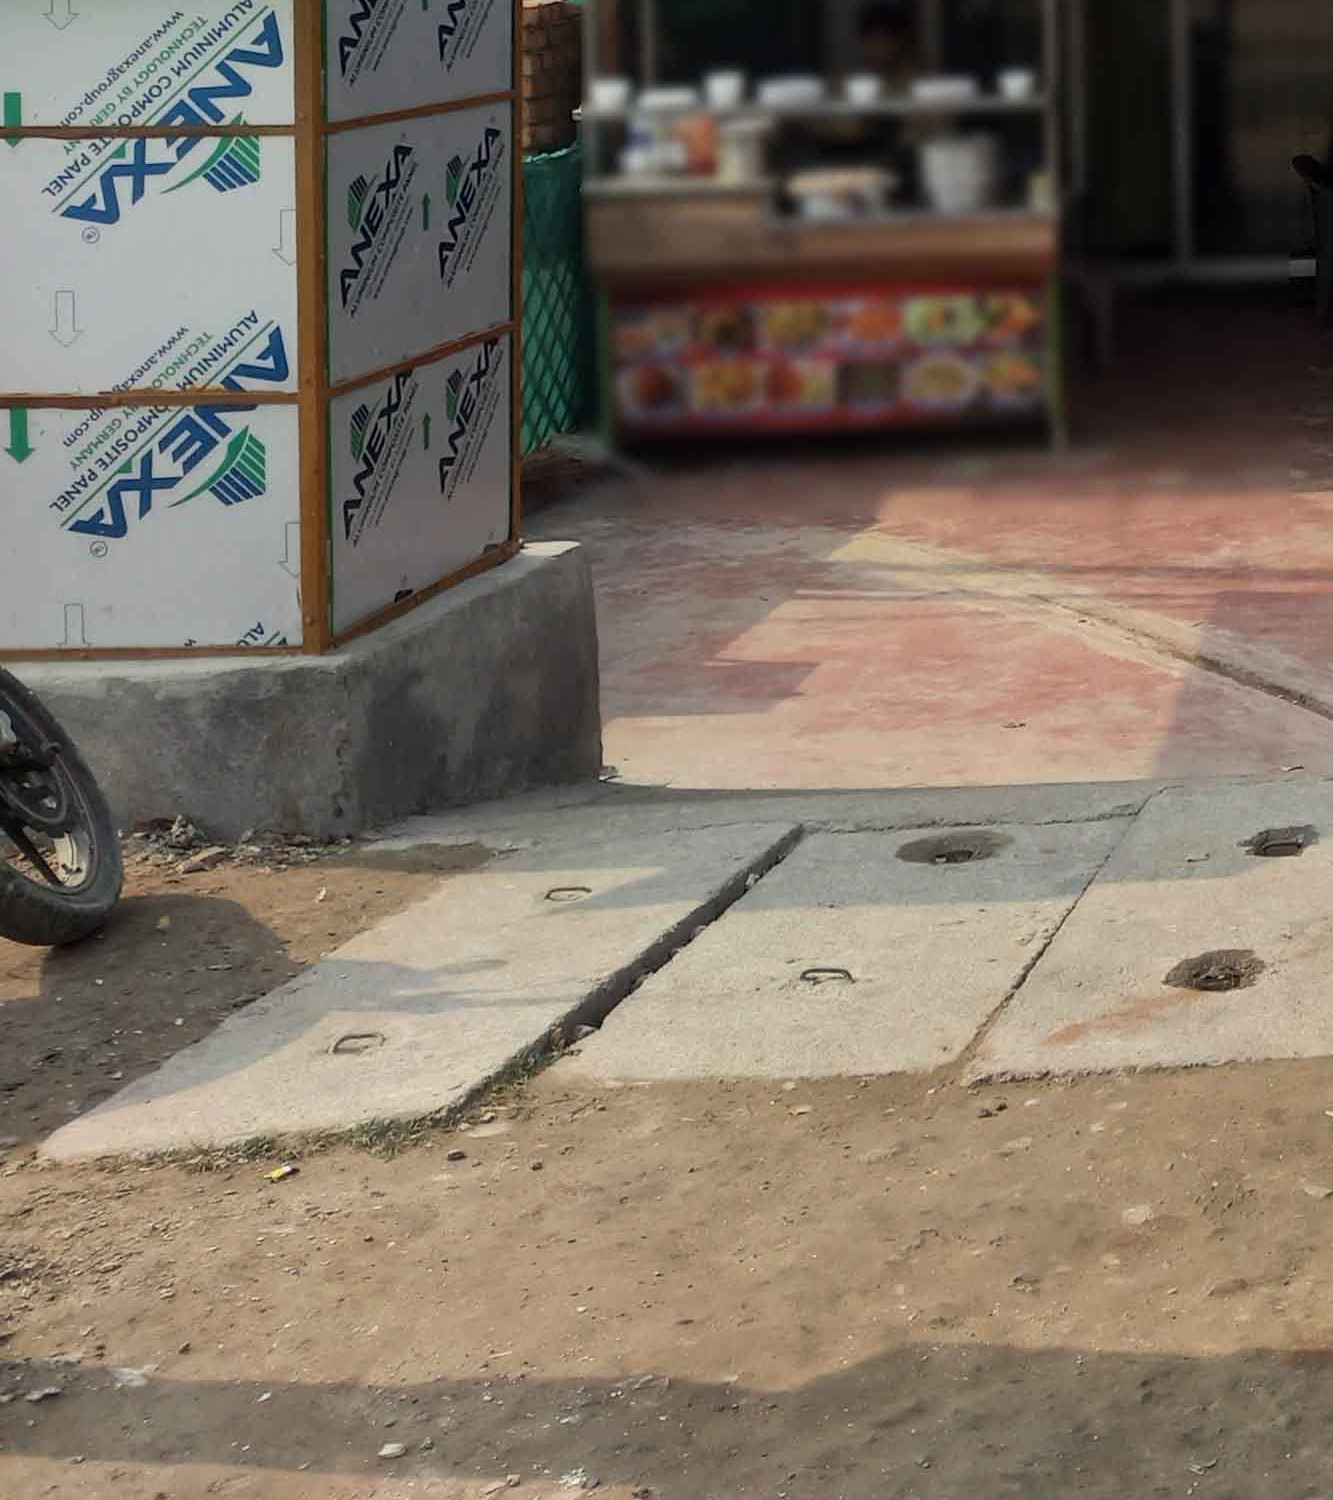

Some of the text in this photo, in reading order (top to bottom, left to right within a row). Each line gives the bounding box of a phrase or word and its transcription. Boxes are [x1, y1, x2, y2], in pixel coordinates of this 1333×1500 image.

[41, 150, 92, 198] PANEL
[60, 10, 285, 226] ANEXA
[89, 75, 172, 156] COMPOTE
[341, 144, 413, 310] ANEXA
[439, 127, 501, 281] ANEXA
[49, 309, 260, 513] ALUMINIUM OMPOSITE PANEL
[68, 325, 290, 539] ANEXA
[151, 331, 214, 390] TECHNOLO
[69, 418, 122, 471] GERMANY
